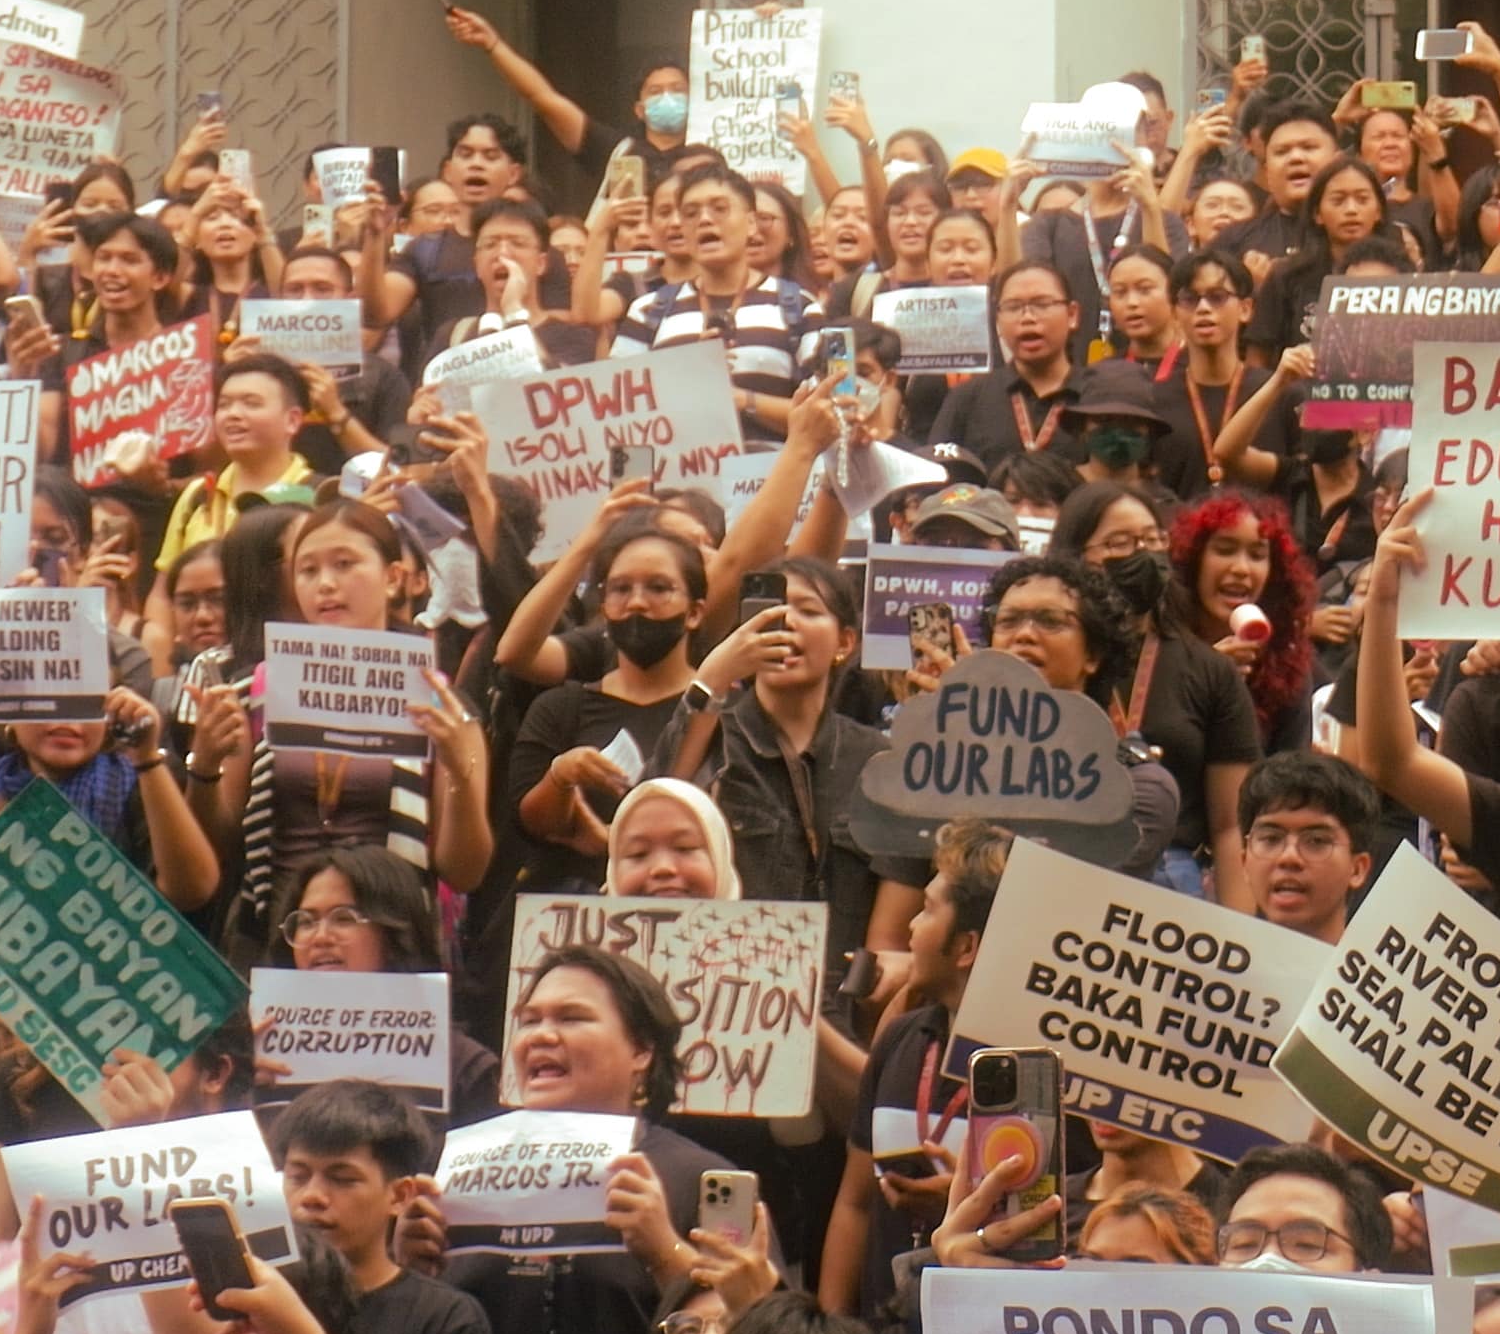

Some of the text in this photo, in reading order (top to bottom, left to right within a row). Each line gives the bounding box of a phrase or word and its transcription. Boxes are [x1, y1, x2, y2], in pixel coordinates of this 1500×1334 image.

[523, 365, 657, 430] DPWH
[937, 681, 1060, 742] FUND
[904, 742, 1102, 799] OUR LABS
[48, 815, 180, 949] PONDO
[59, 887, 215, 1043] BAYAN
[1050, 931, 1282, 1025] CONTROL?
[1102, 903, 1253, 976] FLOOD
[1374, 925, 1488, 1028] RIVER
[1025, 962, 1273, 1067] BAKA FUND
[1336, 950, 1412, 1035] SEA,
[13, 1012, 99, 1097] SESC
[1037, 1010, 1245, 1100] CONTROL
[1316, 988, 1426, 1097] SHALL
[1433, 1078, 1496, 1136] BE
[1117, 1094, 1205, 1142] ETC
[1366, 1109, 1488, 1197] UPSE
